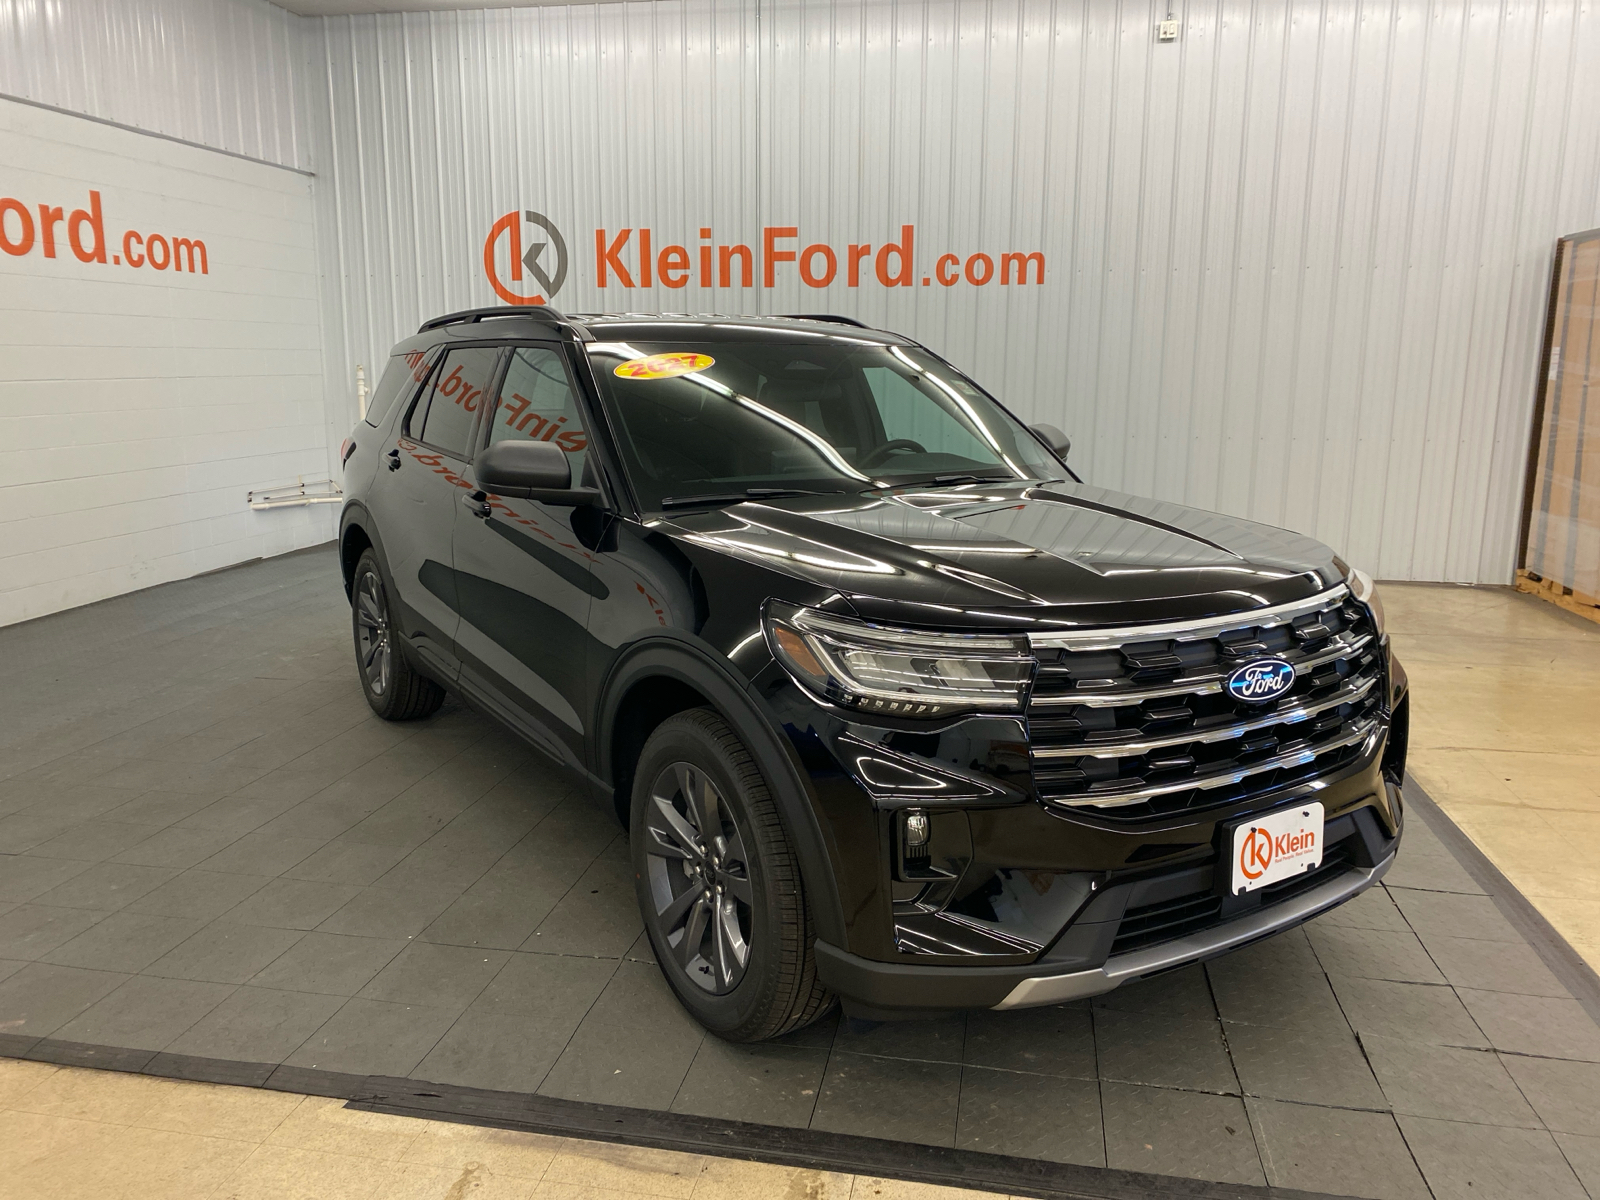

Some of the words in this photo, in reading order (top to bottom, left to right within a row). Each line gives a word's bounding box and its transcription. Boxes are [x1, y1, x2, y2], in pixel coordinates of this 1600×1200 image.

[595, 225, 1046, 289] KleinFord.com
[627, 355, 699, 377] 2027
[1242, 665, 1284, 696] Ford
[1275, 829, 1314, 857] Klein
